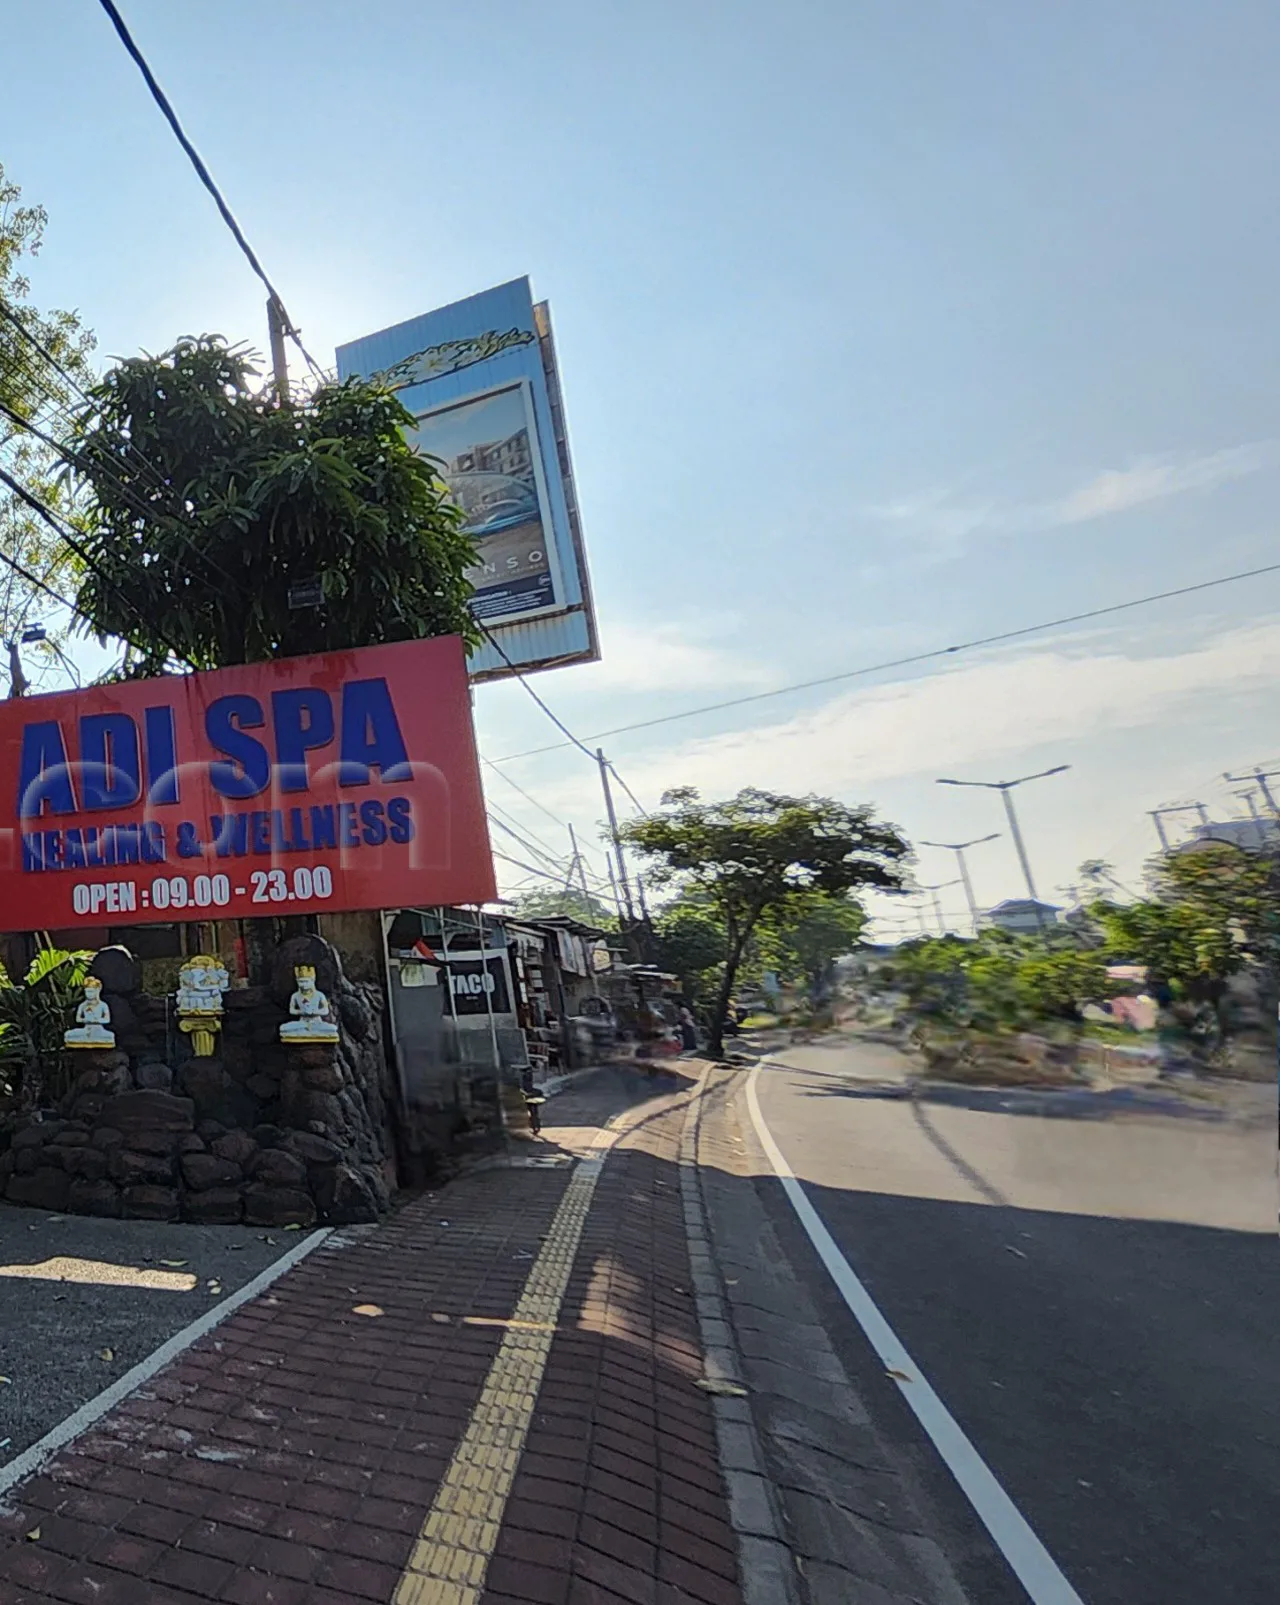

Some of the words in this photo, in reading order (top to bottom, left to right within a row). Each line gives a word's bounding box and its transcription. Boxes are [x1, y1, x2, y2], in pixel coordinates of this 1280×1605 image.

[17, 705, 179, 818] ADI
[205, 677, 414, 799] SPA
[22, 820, 167, 873] HEALING
[176, 821, 204, 859] &
[210, 797, 415, 858] WELLNESS
[72, 881, 137, 915] OPEN
[152, 874, 230, 909] 09.00
[250, 865, 333, 903] 23.00
[446, 973, 495, 994] TACO
